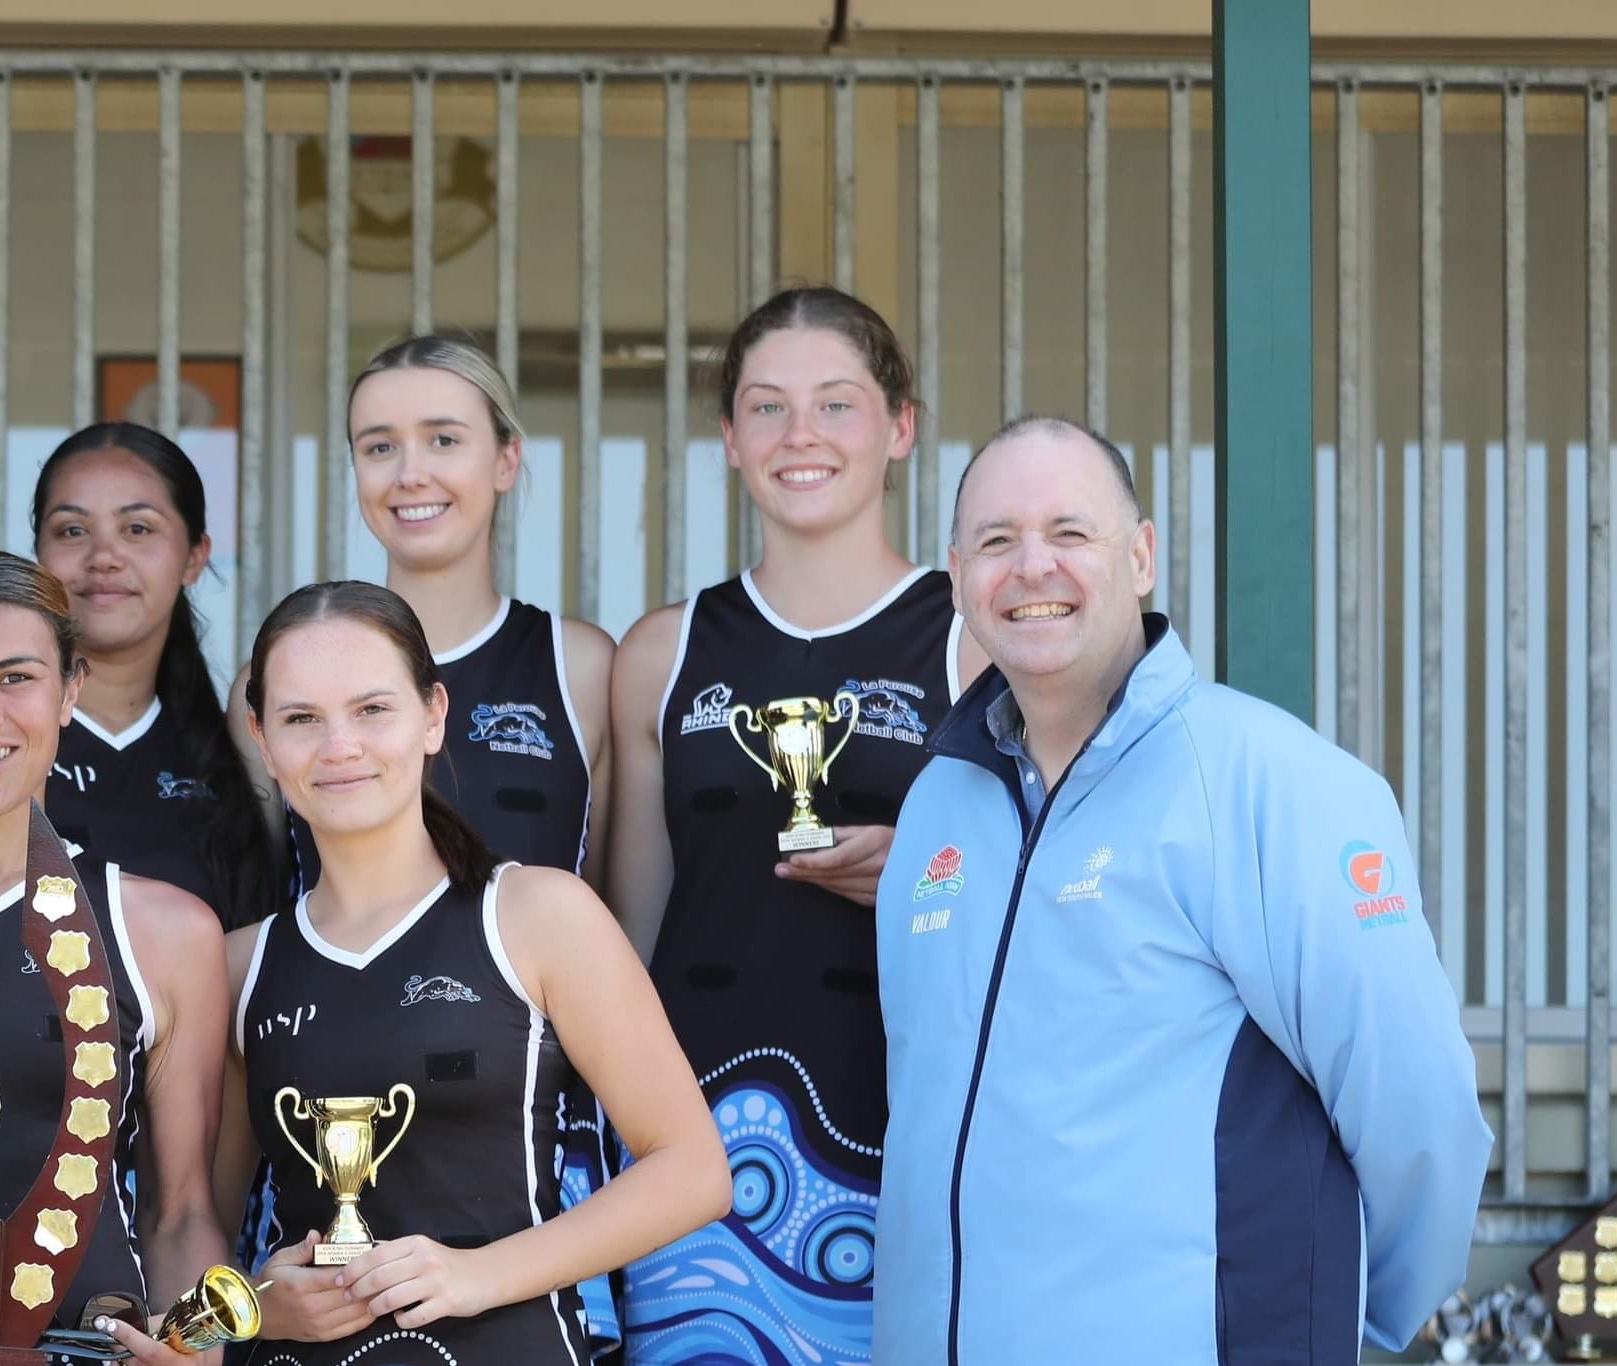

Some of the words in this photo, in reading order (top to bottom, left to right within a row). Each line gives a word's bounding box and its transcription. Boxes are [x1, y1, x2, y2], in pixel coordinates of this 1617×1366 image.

[894, 728, 923, 745] Club
[1354, 895, 1406, 919] GIANTS
[912, 909, 951, 934] VALOUR
